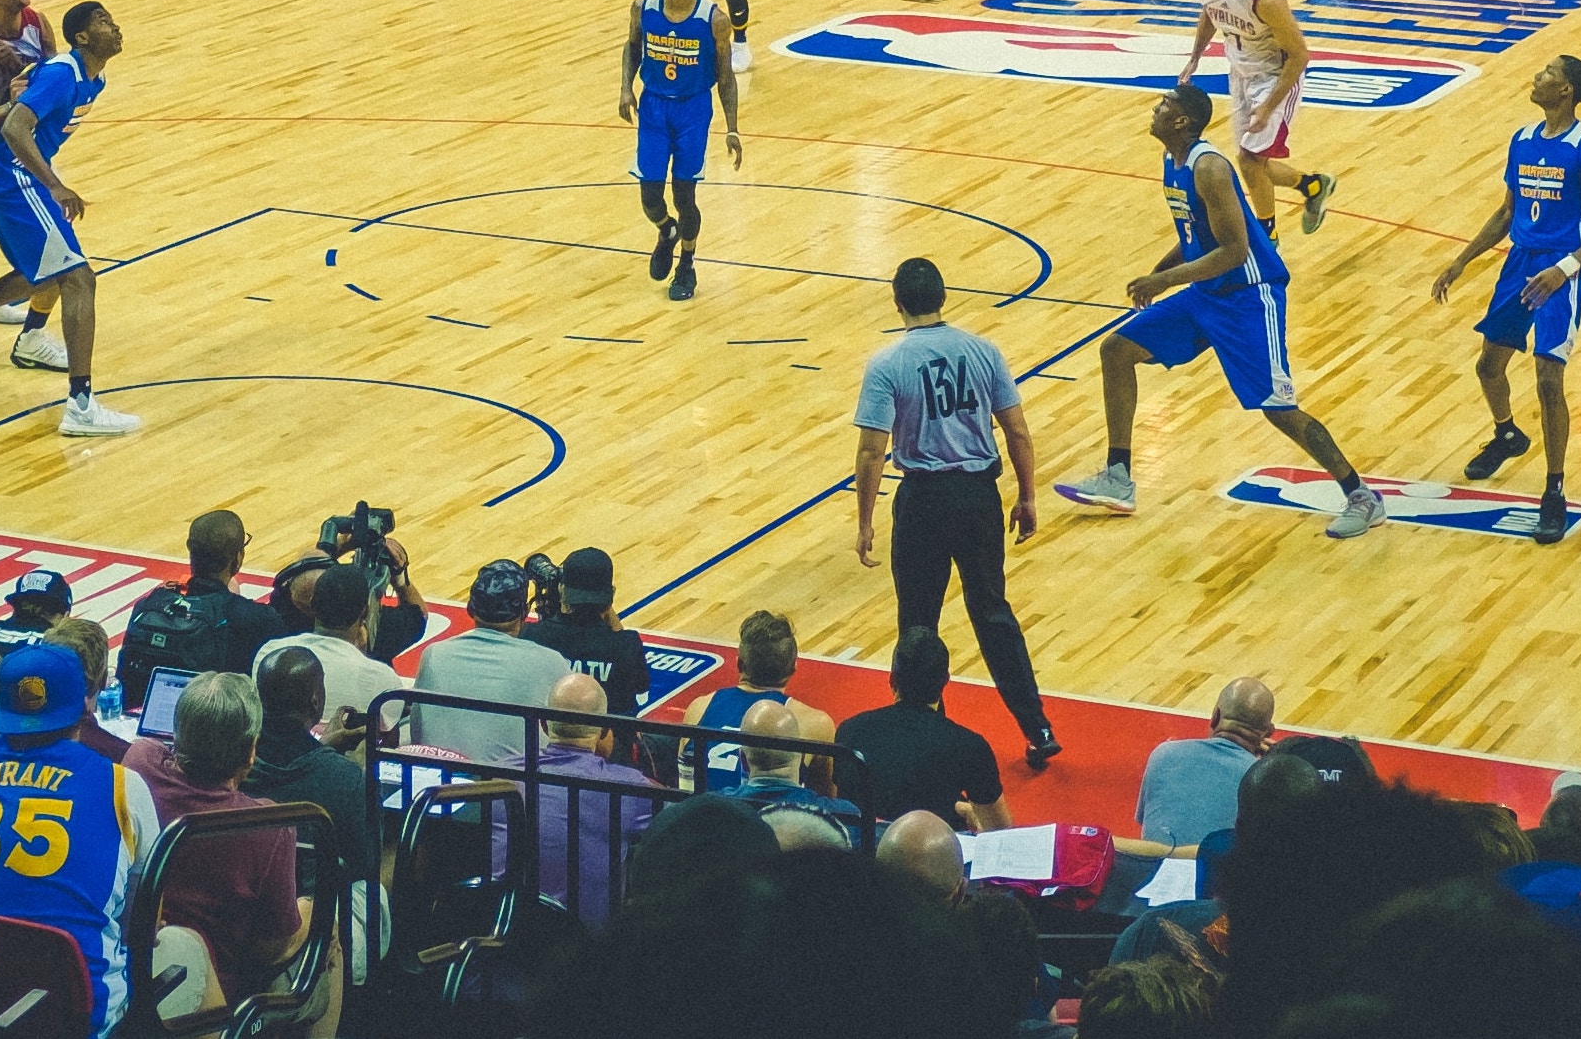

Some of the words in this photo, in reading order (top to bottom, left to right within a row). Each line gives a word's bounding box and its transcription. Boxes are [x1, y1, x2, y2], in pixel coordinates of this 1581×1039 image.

[646, 31, 700, 49] WARRIORS
[664, 64, 677, 81] 6
[1531, 201, 1540, 222] 0
[917, 354, 980, 421] 134
[644, 651, 705, 674] NBA
